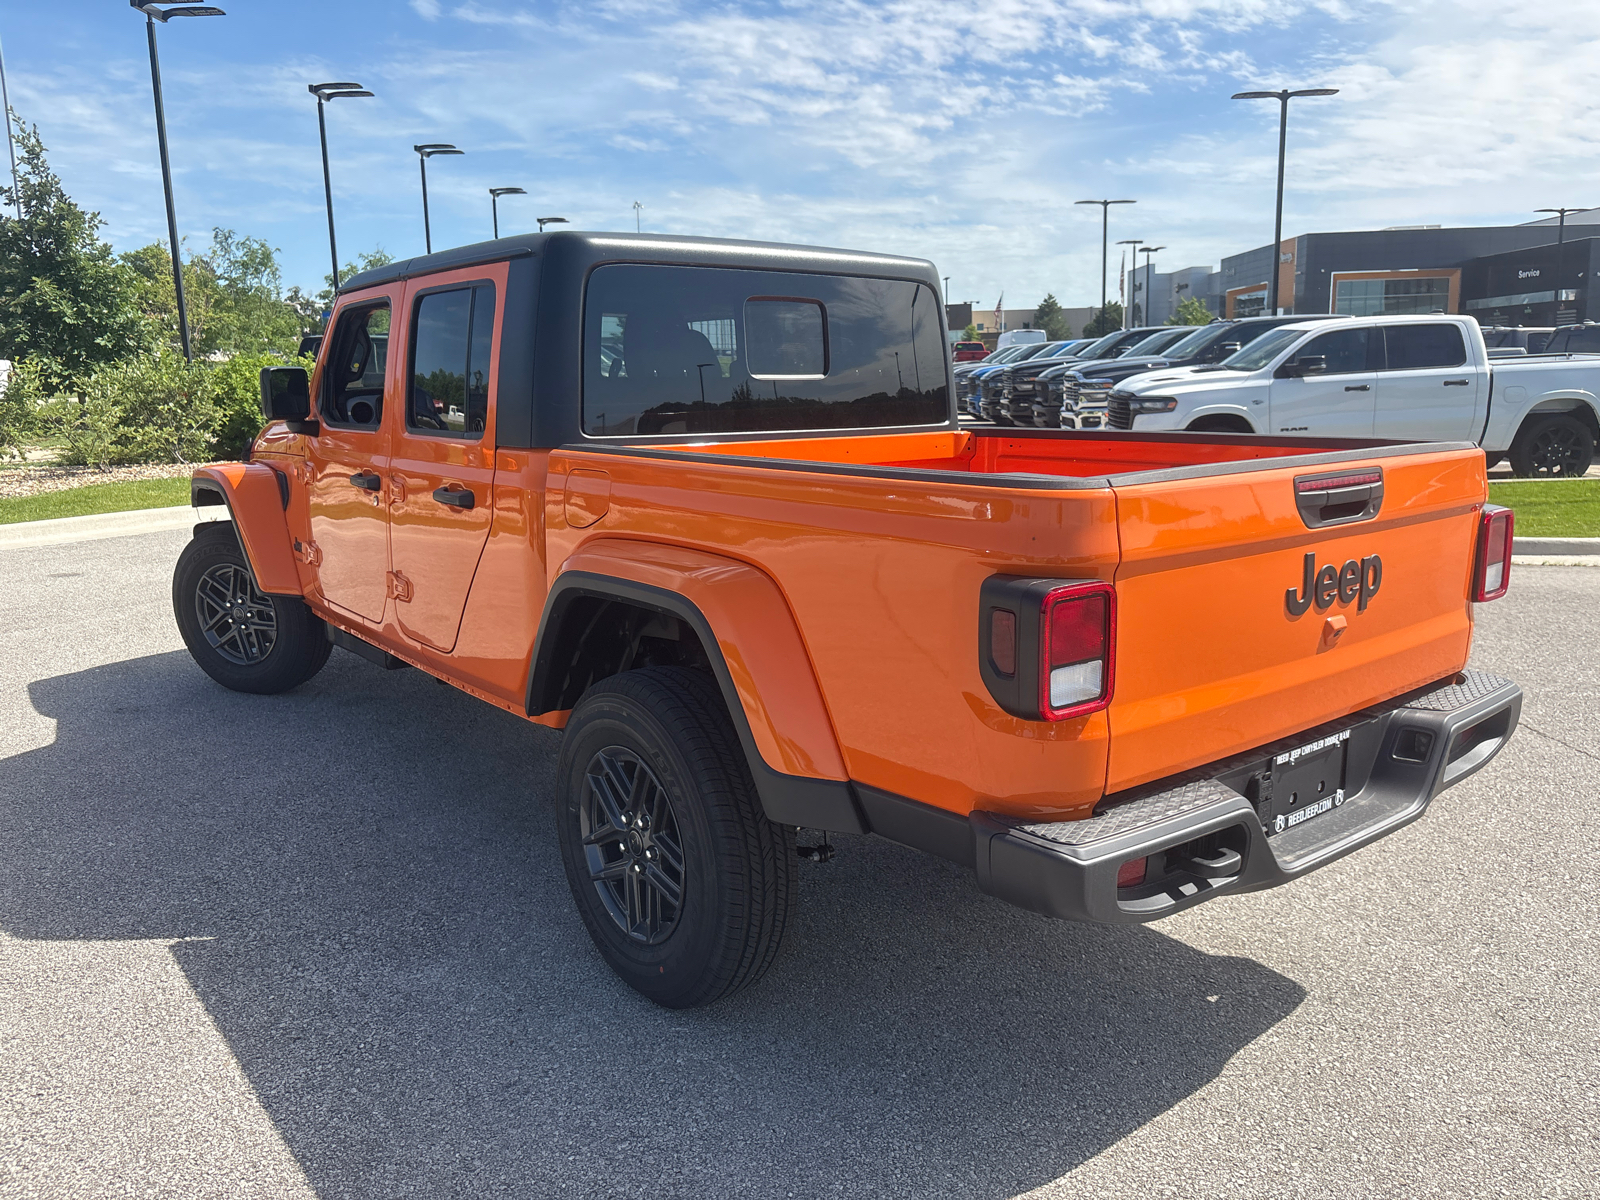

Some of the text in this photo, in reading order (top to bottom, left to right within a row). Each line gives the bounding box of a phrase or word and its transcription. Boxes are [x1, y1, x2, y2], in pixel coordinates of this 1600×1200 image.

[1518, 268, 1540, 279] Service
[1285, 552, 1382, 616] Jeep
[1277, 730, 1350, 765] REED JEEP CHRYSLER DODGE RAM
[1288, 798, 1332, 827] REEDJEEP.COM
